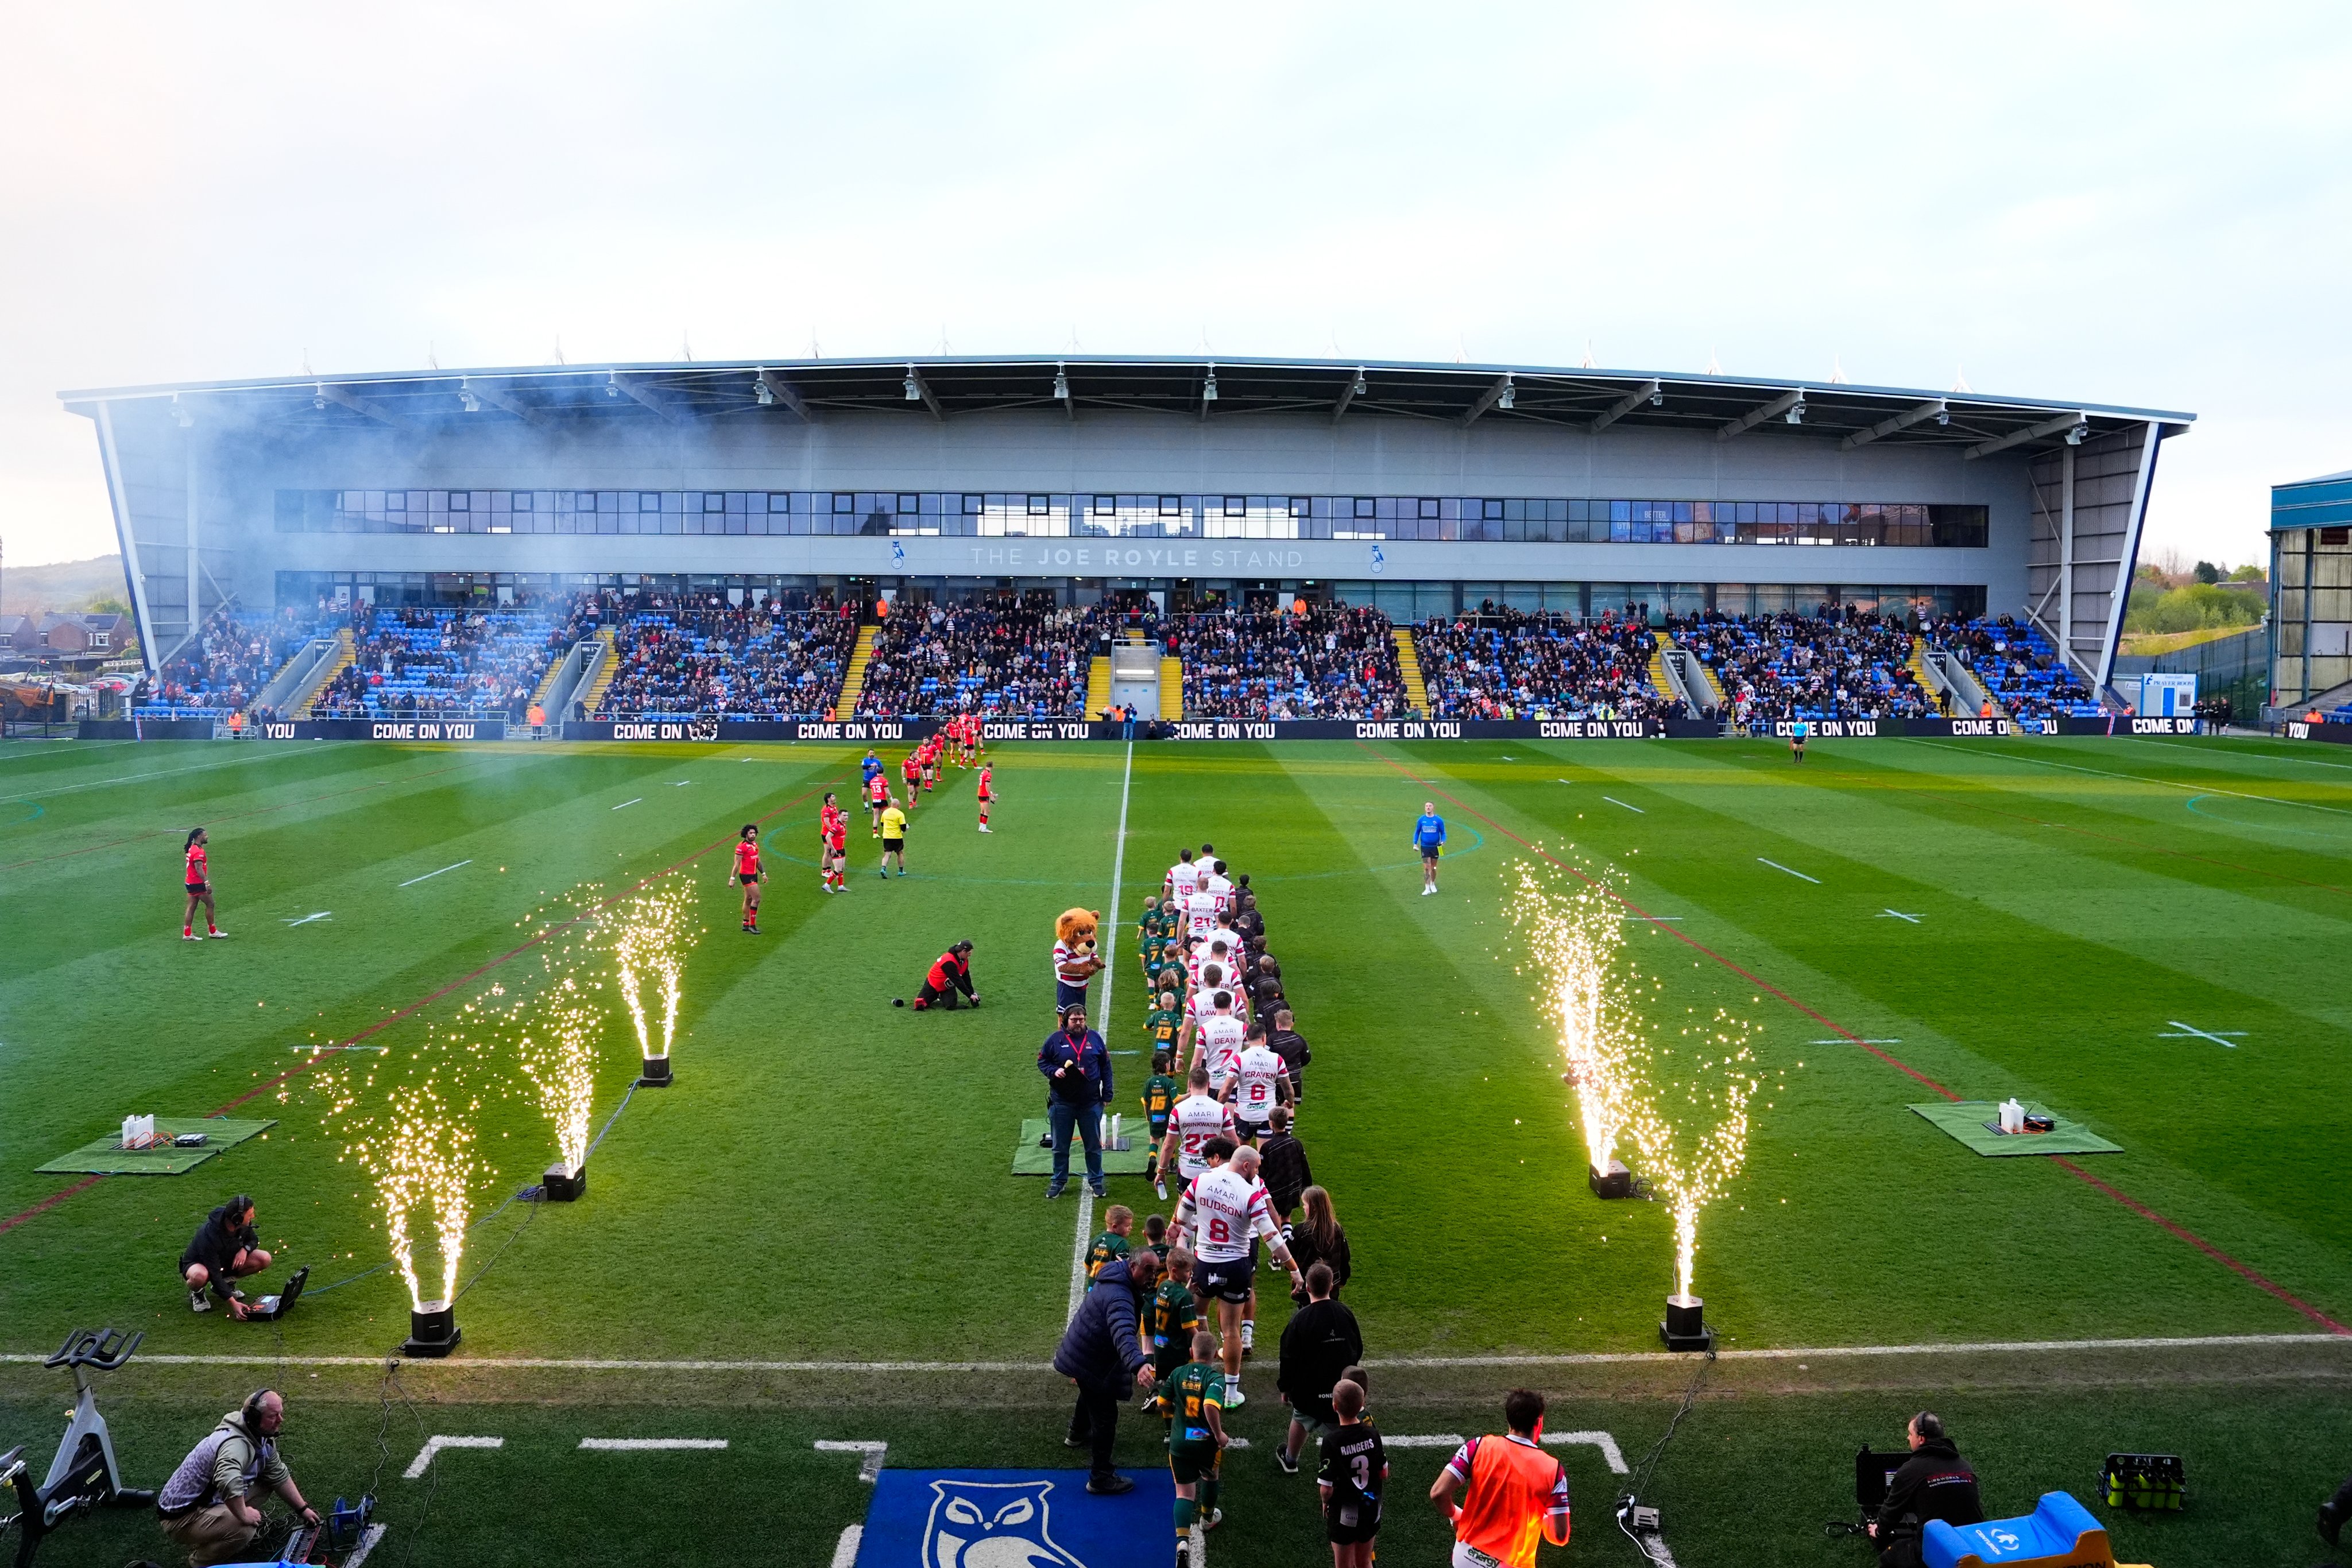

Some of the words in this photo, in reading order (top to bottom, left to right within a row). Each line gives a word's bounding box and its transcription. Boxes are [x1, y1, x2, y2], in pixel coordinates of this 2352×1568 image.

[970, 548, 1022, 565] THE
[1037, 548, 1090, 566] JOE
[1105, 549, 1197, 567] ROYLE
[1212, 550, 1302, 567] STAND
[266, 723, 295, 739] YOU
[373, 724, 415, 739] COME
[419, 724, 440, 739] ON
[445, 724, 474, 739] YOU
[614, 724, 657, 740] COME
[661, 724, 682, 740] ON
[798, 723, 841, 739] COME
[846, 723, 865, 739] ON
[871, 723, 903, 739] YOU
[984, 723, 1027, 739] COME
[1031, 723, 1053, 739] ON
[1058, 723, 1089, 739] YOU
[1218, 723, 1239, 739] ON
[1244, 723, 1275, 739] YOU
[1356, 723, 1399, 738] COME
[1403, 723, 1424, 738] ON
[1429, 723, 1460, 738] YOU
[1540, 722, 1583, 738] COME
[1587, 722, 1608, 738] ON
[1612, 722, 1643, 738] YOU
[1822, 721, 1842, 736] ON
[1846, 721, 1877, 736] YOU
[1952, 720, 1994, 735] COME
[1997, 720, 2010, 735] O
[2132, 719, 2173, 734] COME
[2176, 719, 2195, 734] ON
[2288, 722, 2310, 740] YOU
[872, 785, 882, 793] 13
[1178, 885, 1193, 896] 19
[1194, 917, 1210, 927] 21
[1151, 951, 1159, 962] 7
[1155, 1027, 1173, 1040] 13
[1219, 1049, 1233, 1066] 7
[1245, 1071, 1276, 1079] CRAVEN
[1251, 1084, 1266, 1101] 6
[1206, 1185, 1238, 1202] AMARI
[1209, 1218, 1229, 1243] 8
[1094, 1248, 1109, 1257] SAINTS
[1156, 1297, 1170, 1308] SAINTS
[1182, 1380, 1201, 1391] SAINTS
[1340, 1438, 1374, 1456] RANGERS
[1351, 1454, 1370, 1490] 3
[1975, 1529, 2002, 1555] CENTURION
